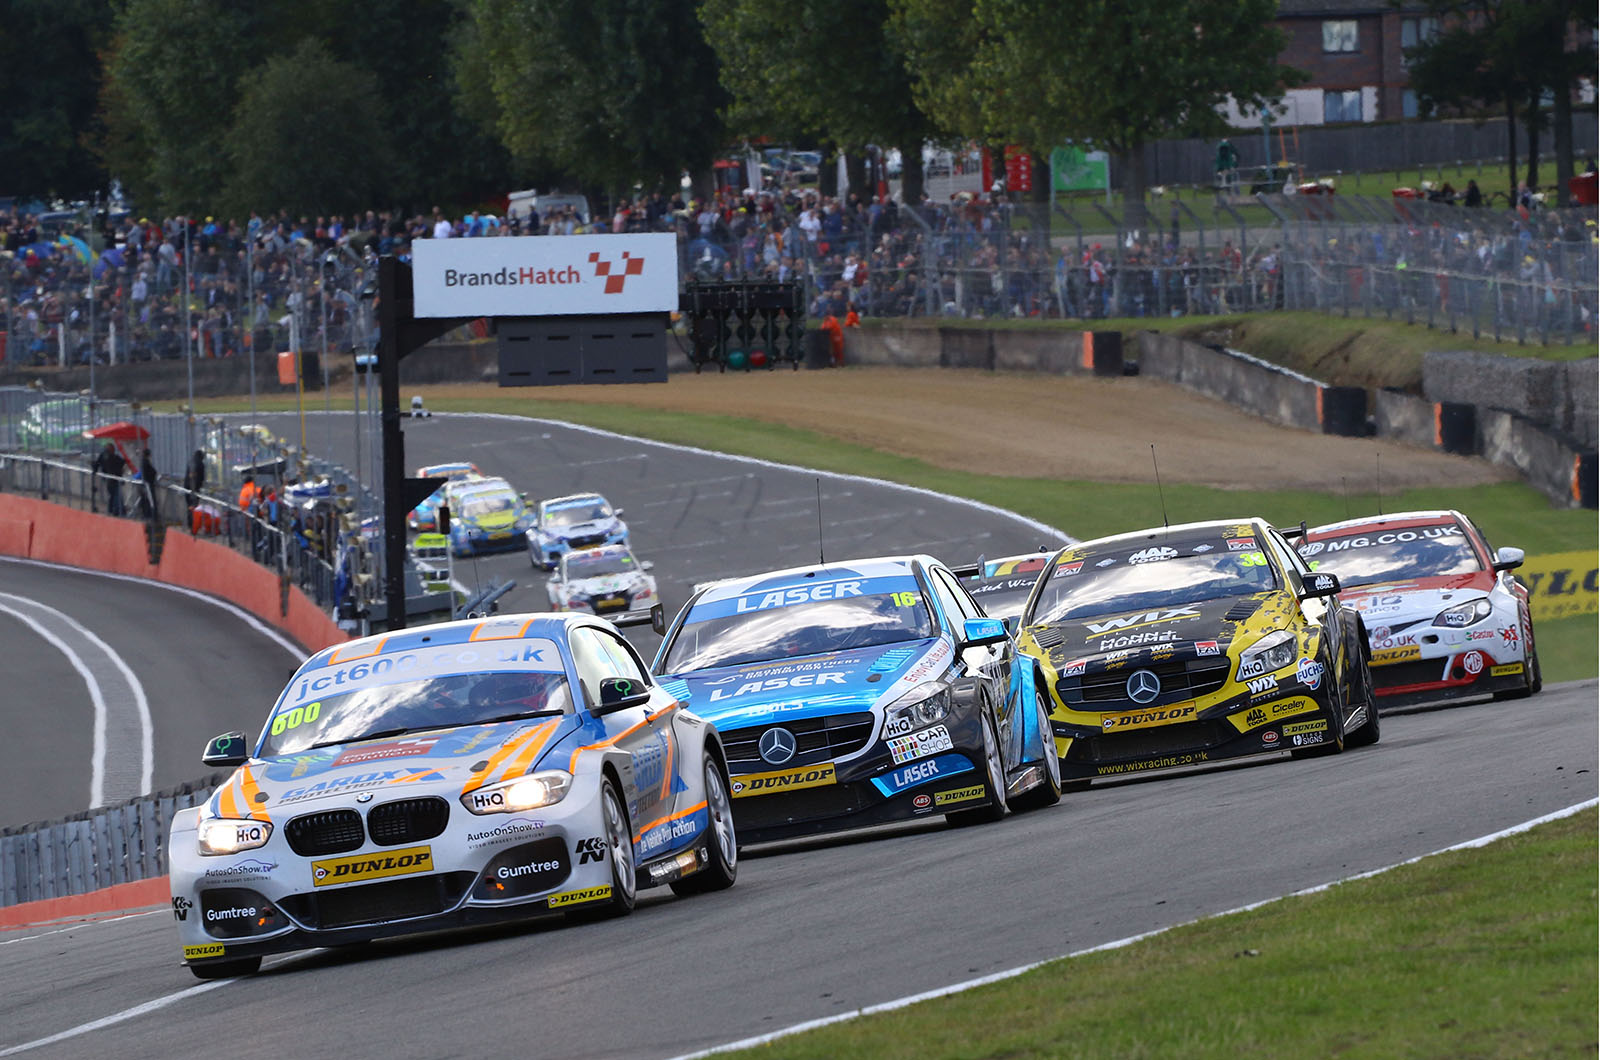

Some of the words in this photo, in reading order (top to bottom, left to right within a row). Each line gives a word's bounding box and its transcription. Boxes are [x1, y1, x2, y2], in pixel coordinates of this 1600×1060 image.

[1327, 526, 1464, 552] MG.CO.UK
[1315, 583, 1334, 591] TOOLS
[737, 581, 863, 613] LASER
[890, 591, 916, 607] 16
[1086, 605, 1201, 633] WIX
[1446, 614, 1464, 622] HiQ
[976, 626, 999, 636] LASER
[1472, 630, 1495, 640] Castrol
[1106, 649, 1128, 661] WIX
[1150, 642, 1174, 652] WIX
[1243, 662, 1263, 676] HiQ
[1297, 662, 1324, 683] FUCHS
[710, 672, 847, 702] LASER
[1246, 674, 1279, 694] WIX
[1272, 700, 1306, 714] Ciceley
[271, 702, 321, 736] 600
[1118, 706, 1195, 726] DUNLOP
[1246, 709, 1266, 723] MAC
[1247, 717, 1268, 727] TOOLS
[886, 719, 910, 736] HiQ
[916, 725, 948, 743] CAR
[1291, 721, 1326, 732] DUNLOP
[920, 738, 950, 755] SHOP
[1303, 734, 1323, 745] SIGNS
[749, 769, 834, 790] DUNLOP
[893, 760, 940, 787] LASER
[474, 792, 504, 810] HiQ
[944, 787, 984, 801] DUNLOP
[237, 828, 261, 843] HiQ
[467, 822, 544, 842] AutosOnShow.tv
[205, 865, 272, 877] AutosOnShow.tv
[333, 852, 430, 877] DUNLOP
[498, 860, 560, 880] Gumtree
[560, 887, 611, 903] DUNLOP
[207, 904, 257, 922] Gumtree
[185, 944, 224, 956] DUNLOP
